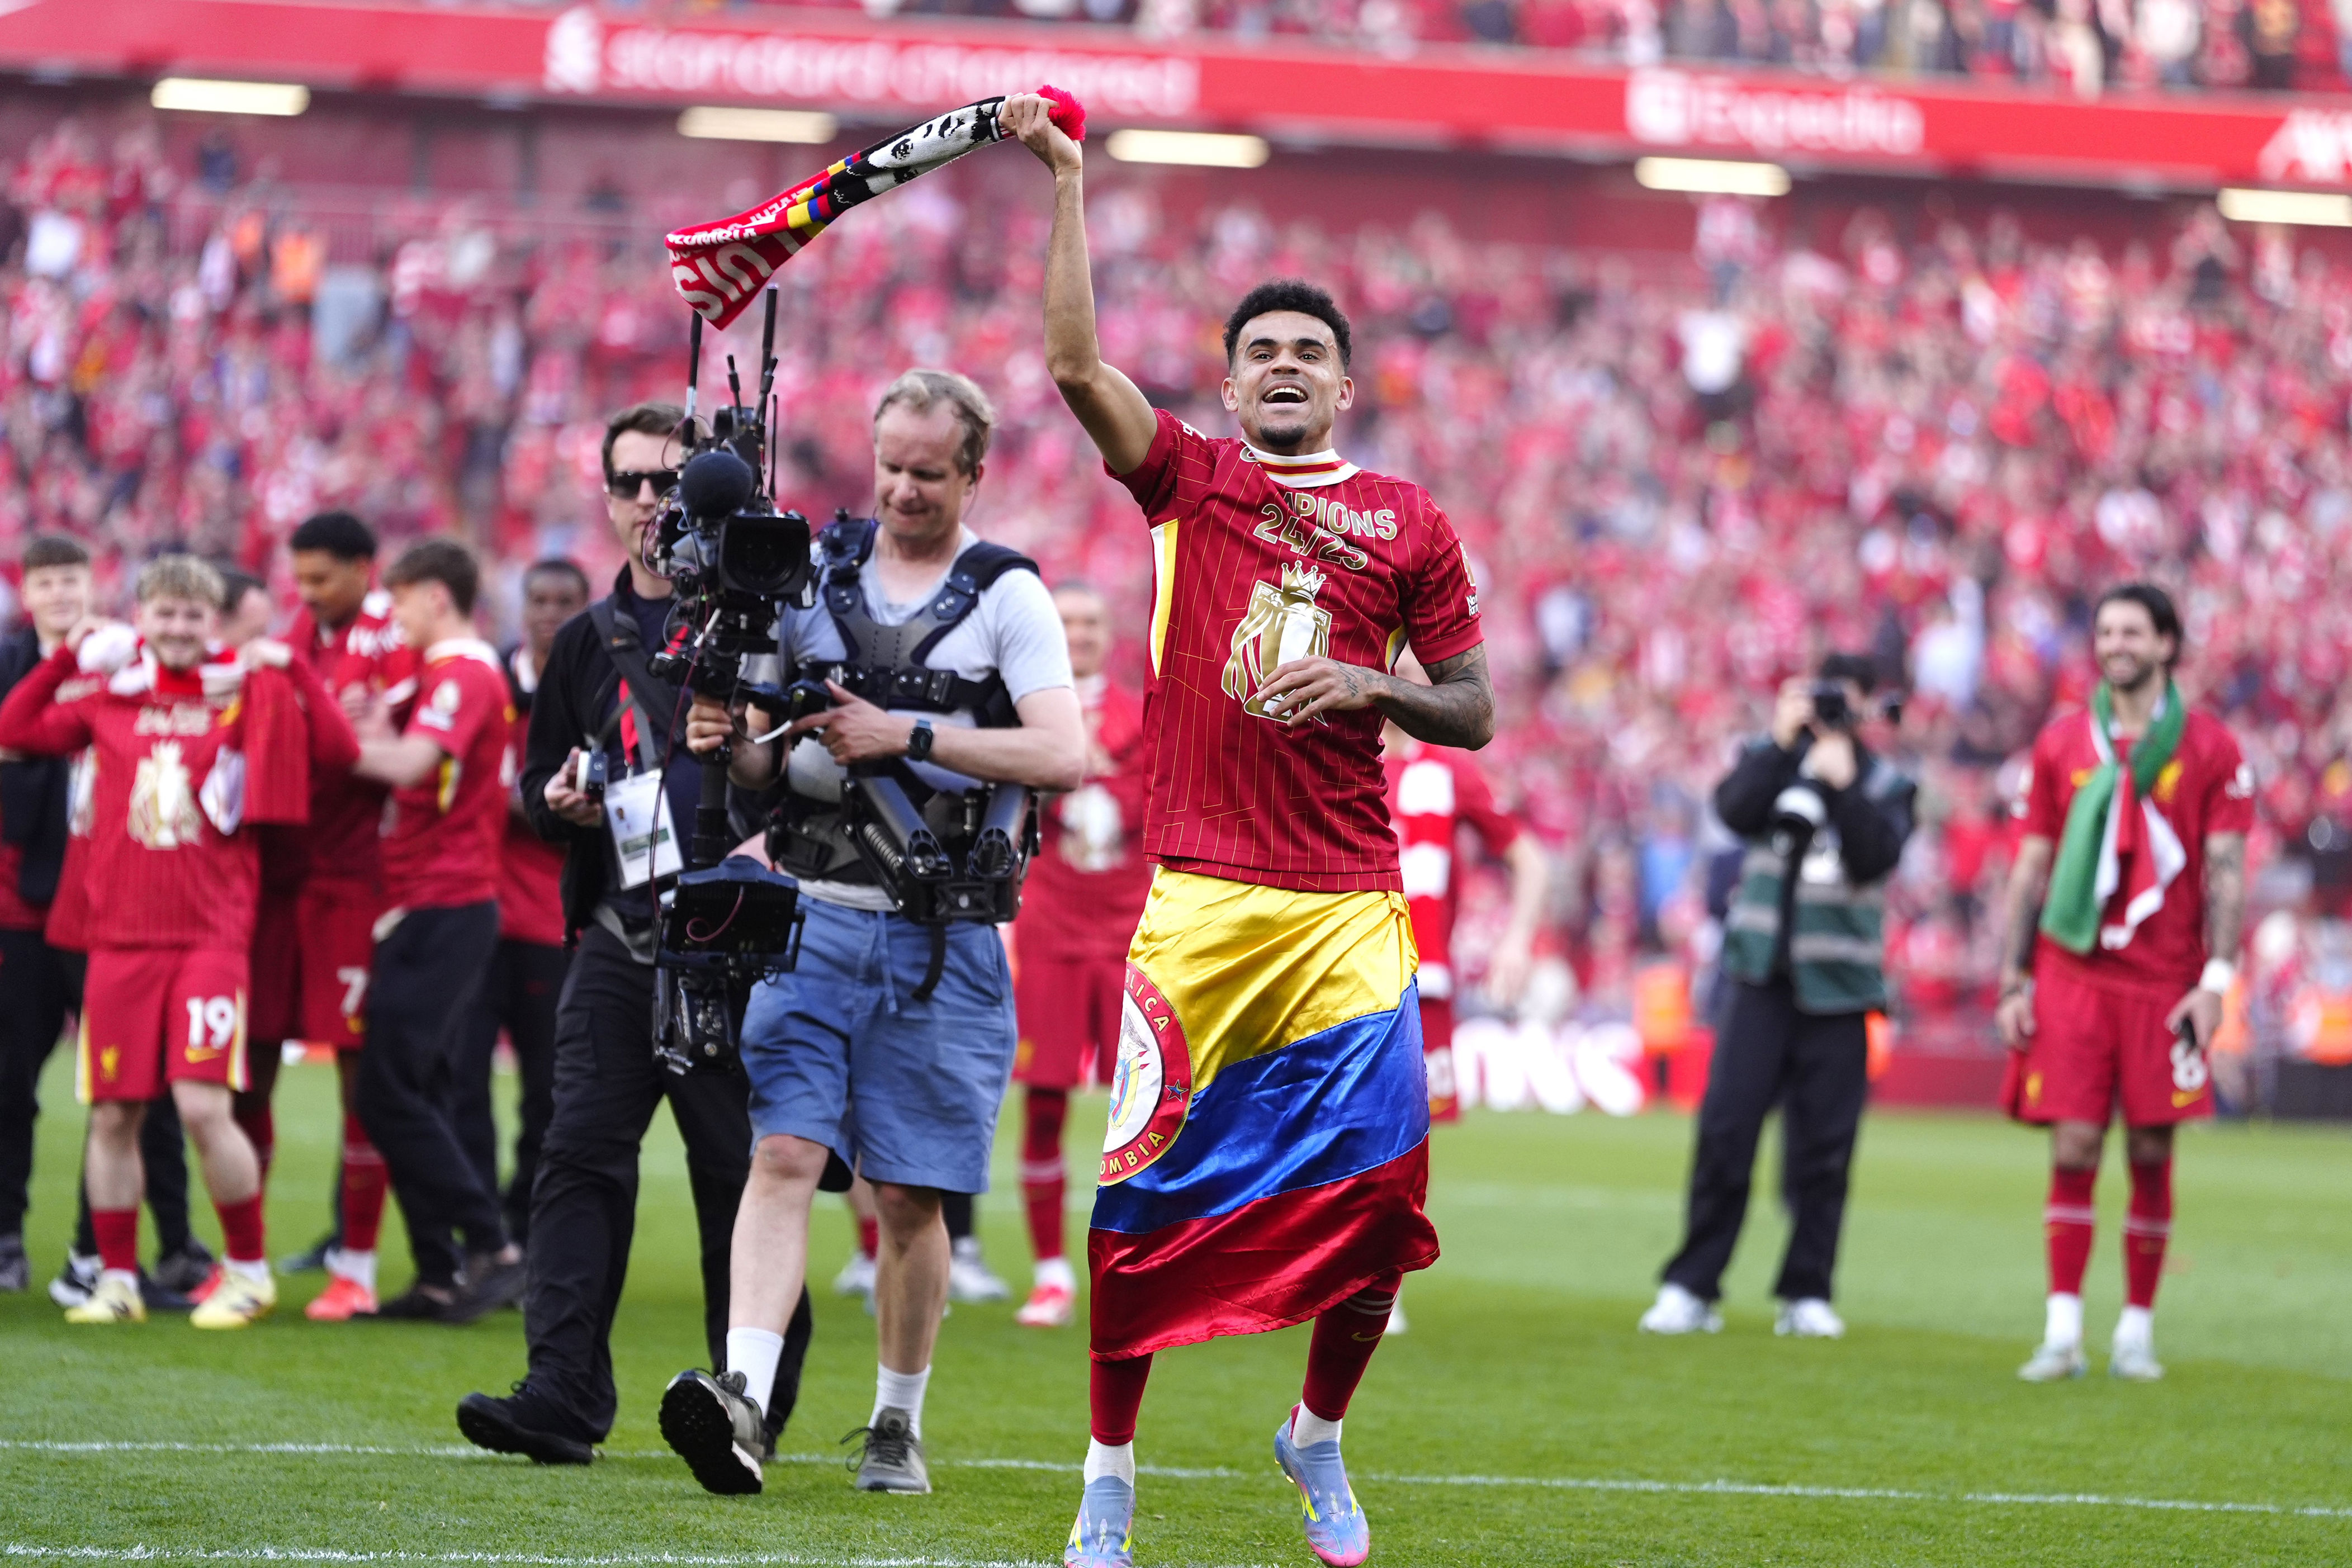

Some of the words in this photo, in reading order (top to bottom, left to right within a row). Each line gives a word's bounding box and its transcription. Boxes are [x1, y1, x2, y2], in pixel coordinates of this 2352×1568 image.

[1253, 503, 1368, 570] 24/25
[337, 967, 368, 1017] 7
[186, 996, 235, 1049] 19
